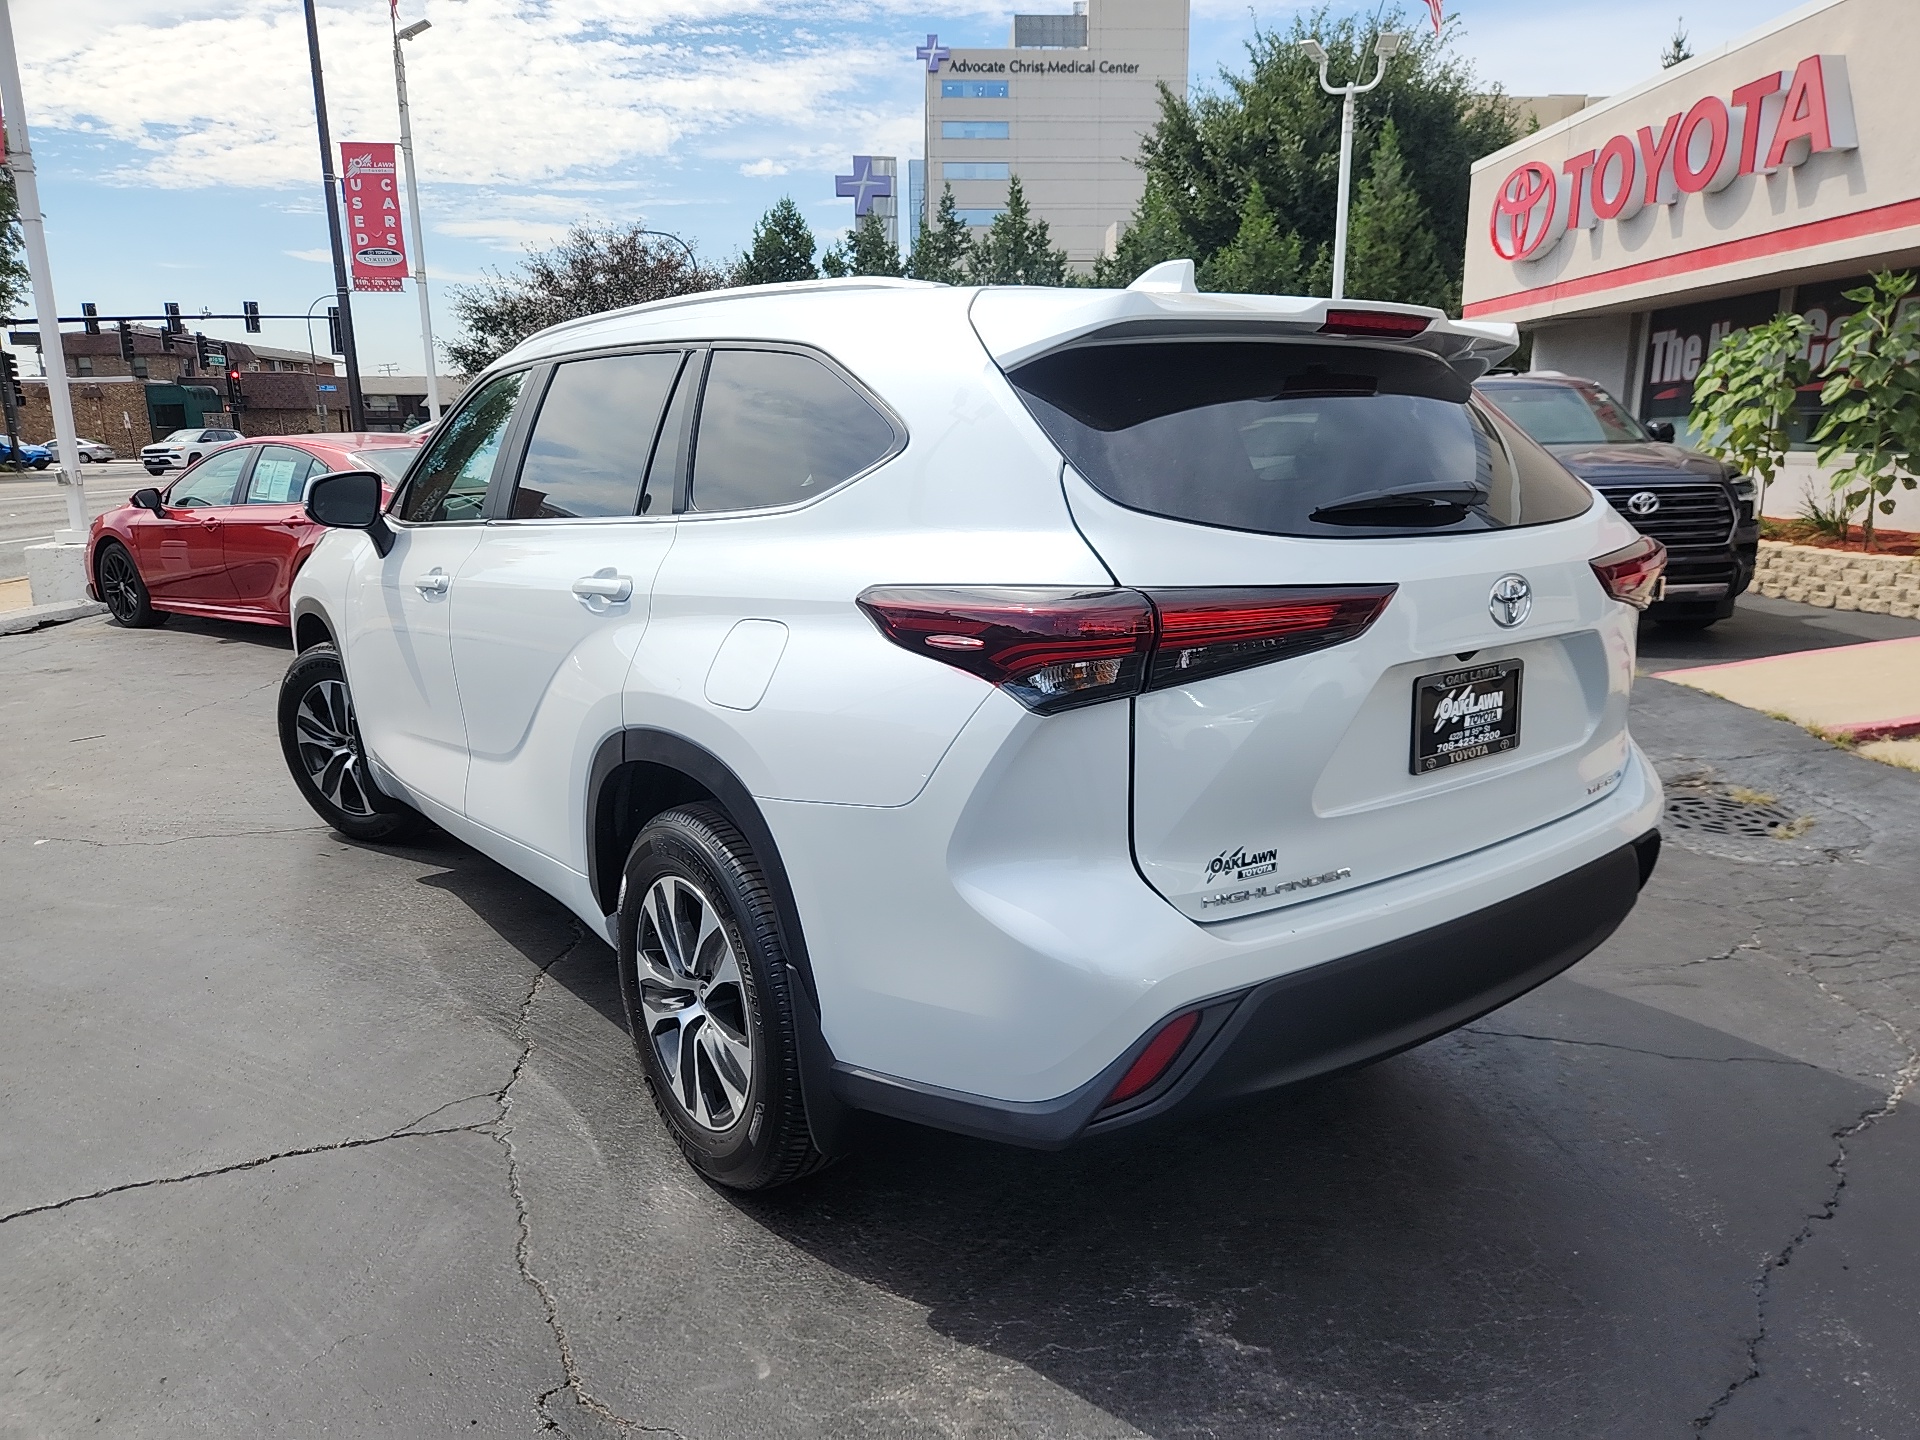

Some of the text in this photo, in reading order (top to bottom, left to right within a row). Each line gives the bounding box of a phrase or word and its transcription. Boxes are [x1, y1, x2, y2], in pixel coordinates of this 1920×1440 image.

[949, 59, 1140, 74] Advocate Christ Medical Center
[1562, 53, 1834, 230] TOYOTA
[350, 178, 369, 246] USED
[380, 178, 397, 246] CARS
[1651, 328, 1702, 384] The
[1446, 666, 1497, 685] OAK LAWN
[1468, 709, 1498, 724] TOYOTA
[1436, 730, 1501, 753] 708-423-5200
[1448, 744, 1489, 763] TOYOTA
[1241, 864, 1273, 878] TOYOTA
[1200, 866, 1352, 909] HIGHLANDER
